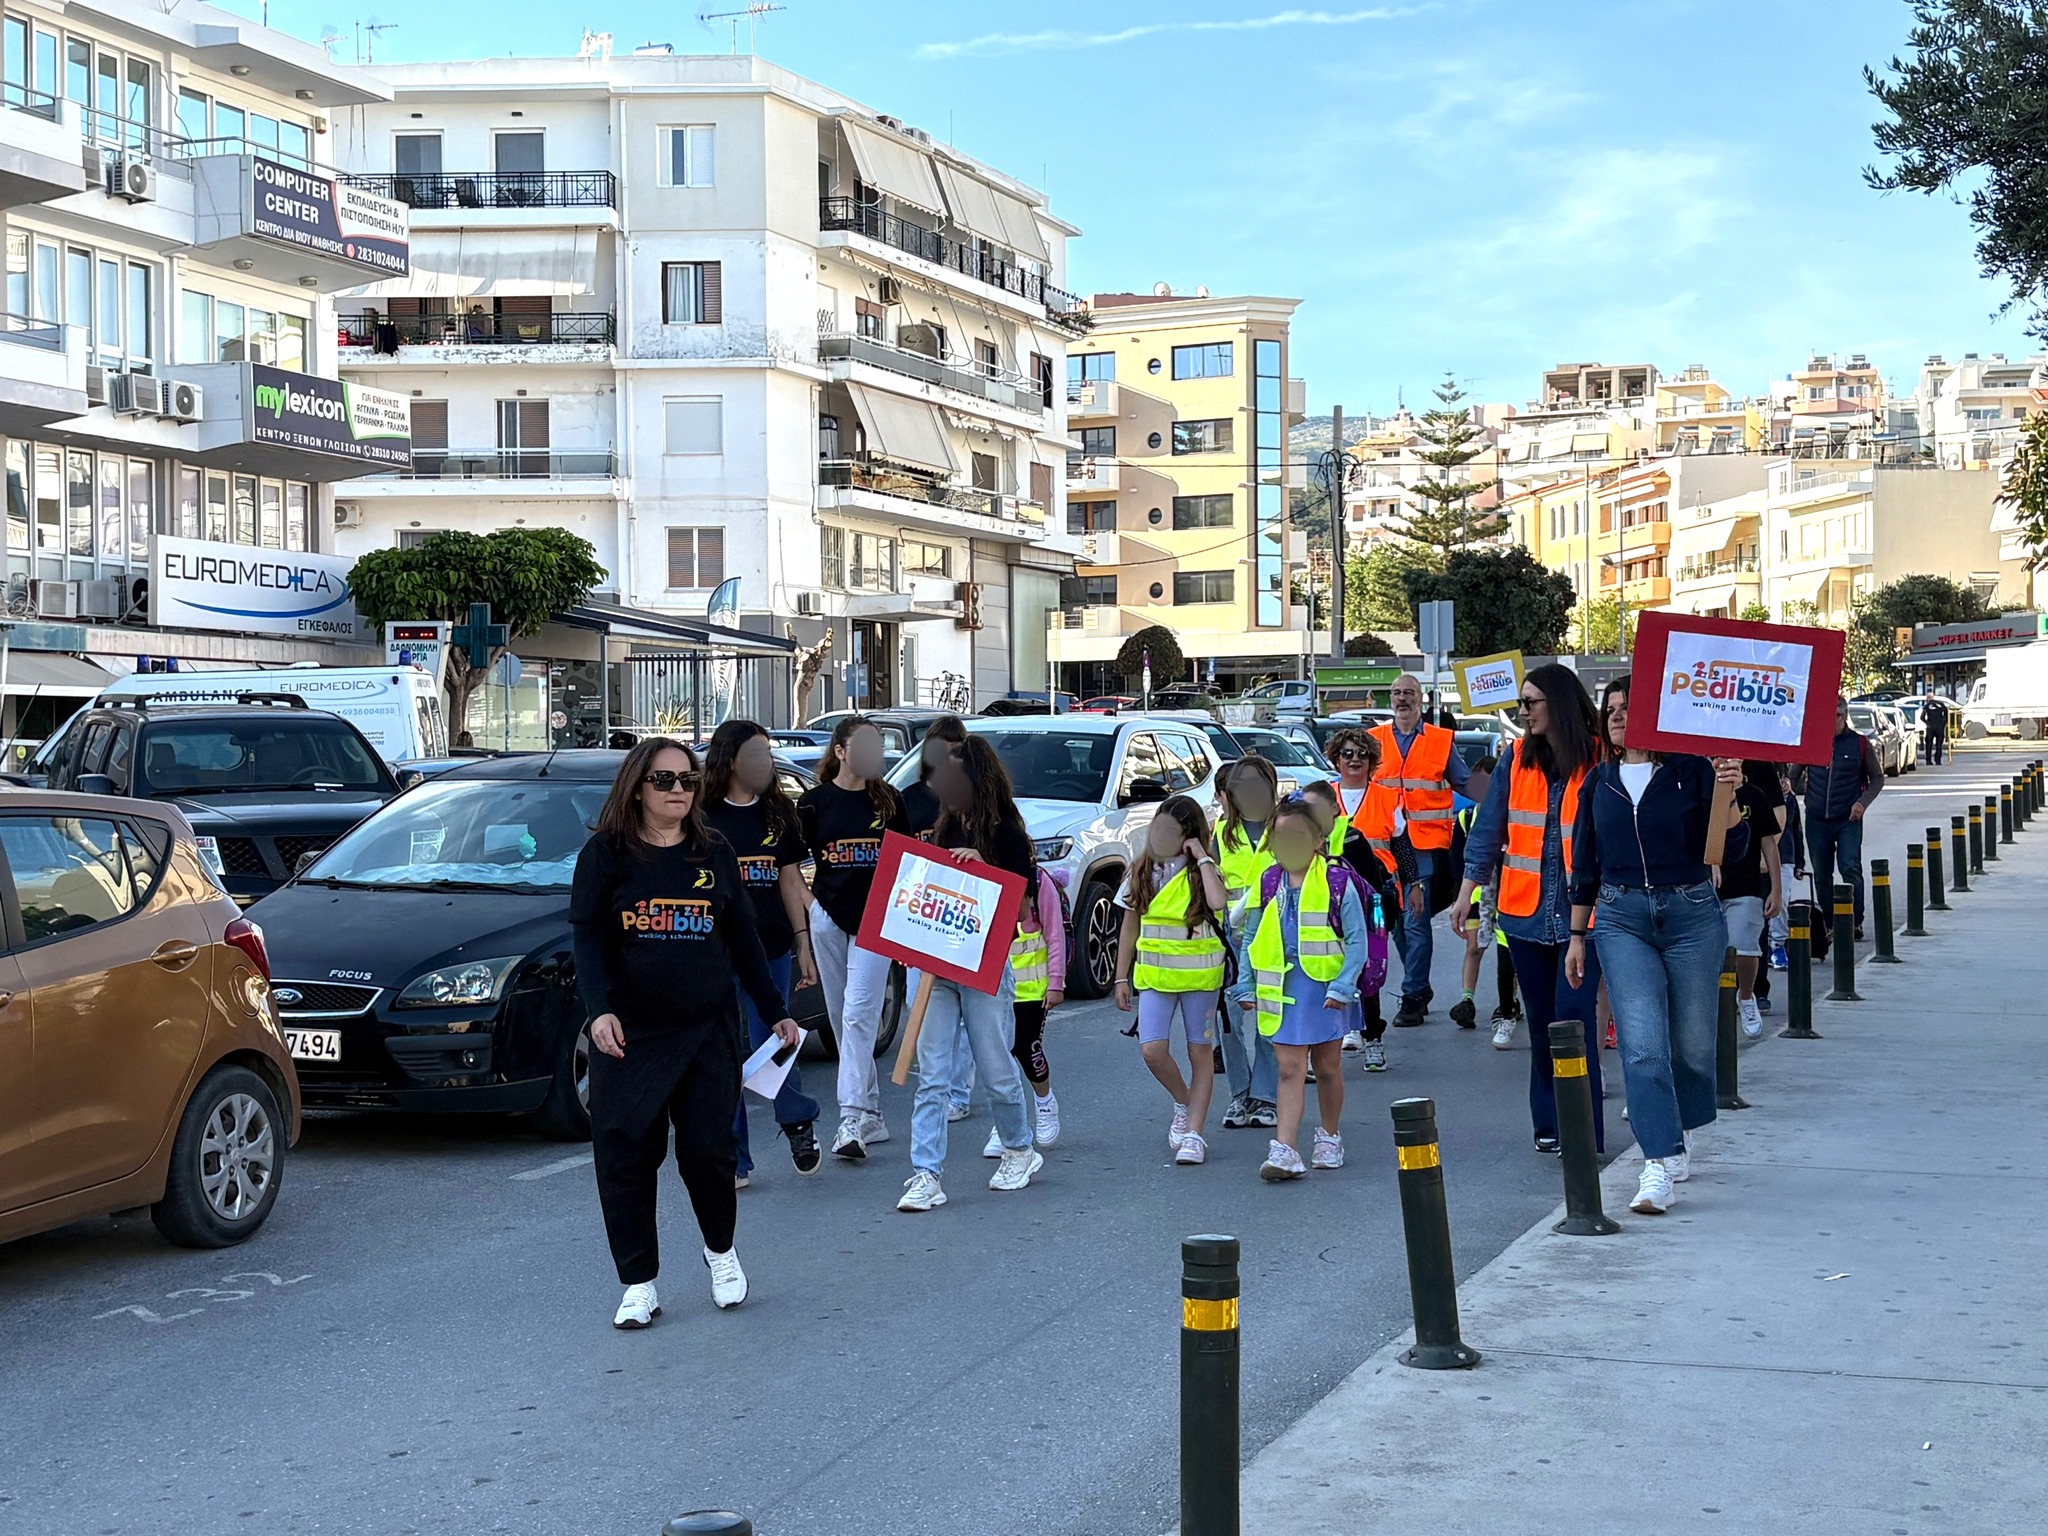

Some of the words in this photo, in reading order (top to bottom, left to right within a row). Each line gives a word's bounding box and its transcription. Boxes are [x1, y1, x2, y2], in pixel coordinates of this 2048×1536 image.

[254, 162, 329, 202] COMPUTER
[265, 192, 319, 224] CENTER
[347, 192, 393, 217] ΕΚΠΑΙΔΕΥΣΗ
[255, 219, 282, 237] ΚΕΝΤΡΟ
[357, 245, 406, 271] 2831024044
[256, 382, 345, 422] mylexicon
[256, 427, 291, 442] ΚΕΝΤΡΟ
[293, 433, 322, 448] ΞΕΝΩΝ
[324, 439, 362, 455] ΓΛΩΣΣΩΝ
[165, 553, 332, 594] EUROMEDICA
[298, 618, 353, 635] ΕΓΚΕΦΑΛΟΣ
[1937, 633, 1968, 646] SUPER
[1970, 628, 2012, 642] MARKET
[280, 680, 376, 693] EUROMEDICA
[1692, 701, 1726, 712] walking
[1731, 704, 1760, 715] school
[1762, 708, 1776, 716] bus
[621, 910, 713, 933] Pedibus
[907, 917, 932, 931] walking
[329, 969, 373, 981] FOCUS
[275, 991, 294, 1001] Ford
[286, 1033, 336, 1058] 7494
